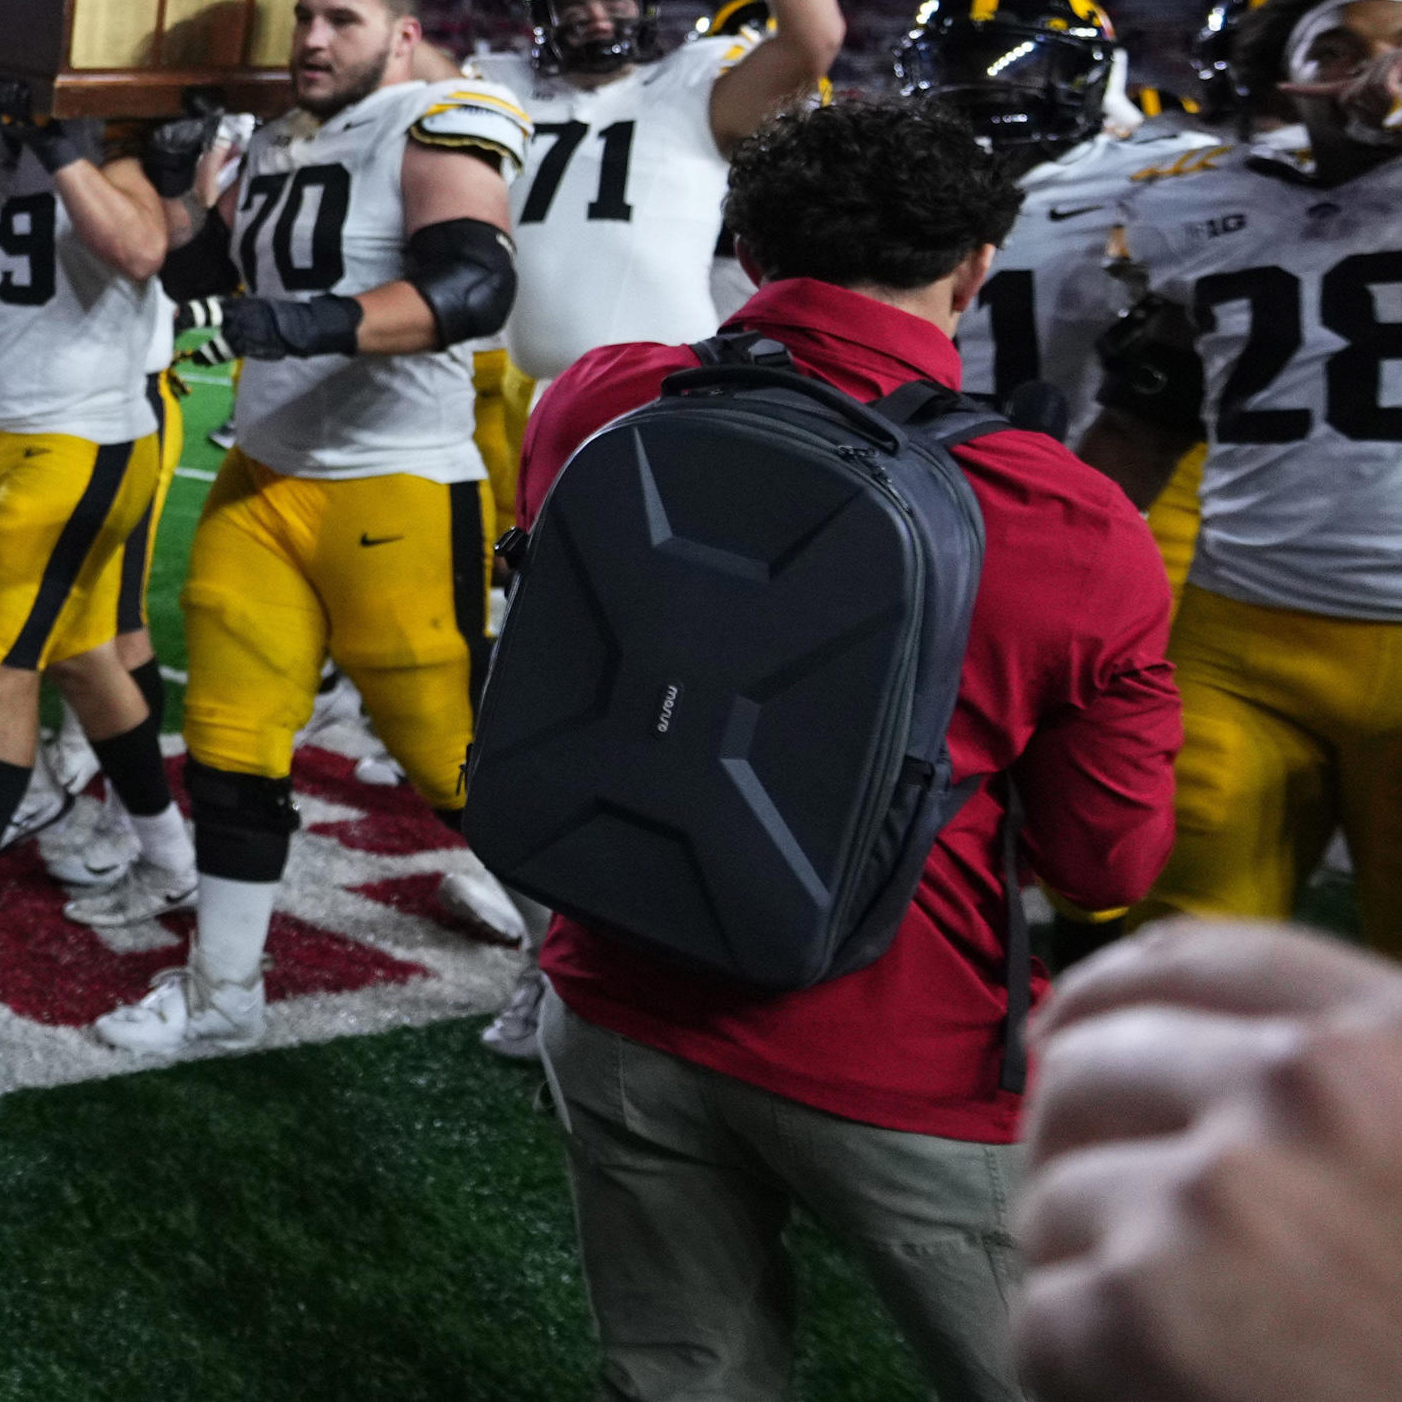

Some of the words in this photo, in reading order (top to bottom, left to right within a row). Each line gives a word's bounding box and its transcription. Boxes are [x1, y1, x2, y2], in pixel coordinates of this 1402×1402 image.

[240, 162, 351, 295] 70
[518, 119, 636, 225] 71
[1194, 250, 1402, 445] 28
